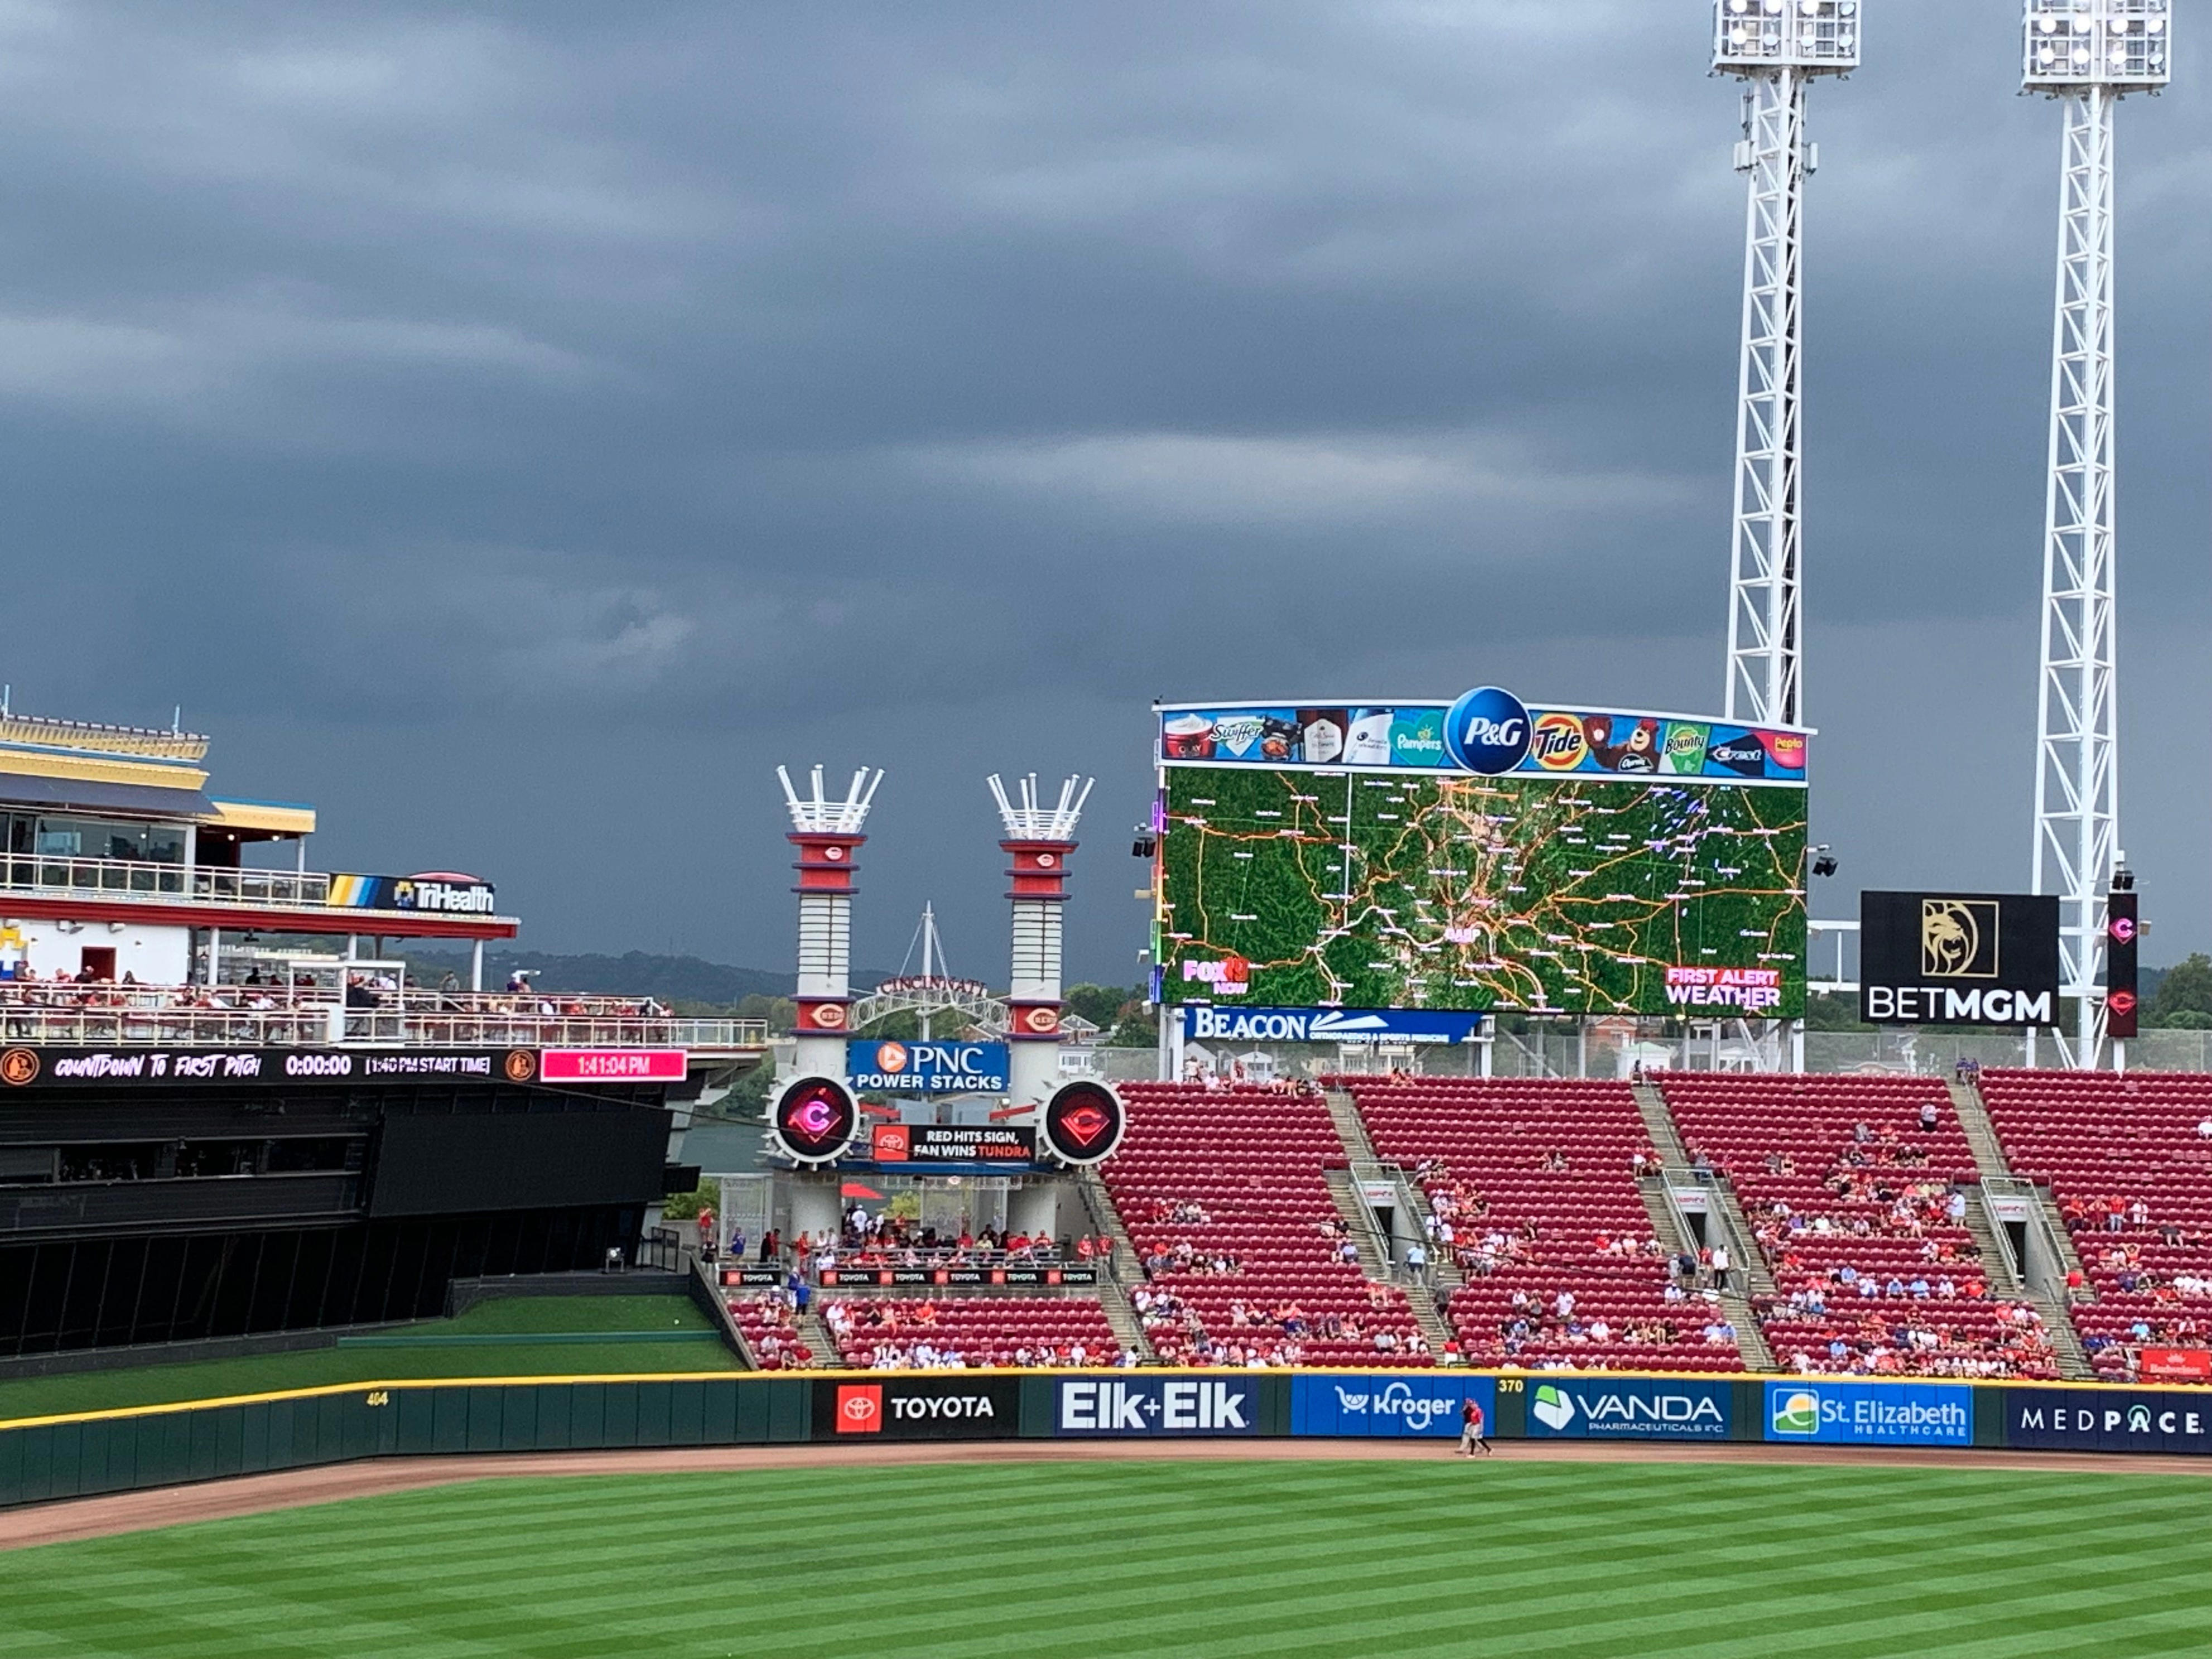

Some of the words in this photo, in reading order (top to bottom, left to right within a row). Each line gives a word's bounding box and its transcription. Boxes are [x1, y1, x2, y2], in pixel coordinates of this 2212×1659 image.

[1209, 724, 1263, 745] Swiffer
[1463, 716, 1524, 746] P&G
[1397, 732, 1442, 752] Pampers
[1536, 727, 1582, 759] Tide
[1665, 736, 1705, 755] Bounty
[1712, 746, 1762, 761] Crest
[414, 882, 494, 912] TriHealth
[880, 975, 987, 997] CINCINNATI
[1667, 968, 1718, 984] FIRST
[1720, 969, 1779, 986] ALERT
[1213, 982, 1249, 995] NOW
[1665, 984, 1781, 1006] WEATHER
[1868, 987, 2051, 1023] BETMGM
[1194, 1008, 1308, 1040] BEACON
[55, 1054, 145, 1078] COUNTDOWN
[150, 1054, 170, 1077] TO
[175, 1054, 227, 1078] FIRST
[224, 1054, 262, 1078] PITCH
[286, 1055, 352, 1075] 0:00:00
[419, 1057, 460, 1073] START
[629, 1057, 650, 1074] PM
[909, 1046, 984, 1074] PNC
[857, 1074, 924, 1088] POWER
[931, 1075, 1003, 1089] STACKS
[926, 1130, 953, 1142] RED
[954, 1131, 983, 1142] HITS
[984, 1131, 1019, 1144] SIGN,
[913, 1144, 940, 1156] FAN
[941, 1145, 976, 1156] WINS
[977, 1145, 1031, 1157] TUNDRA
[743, 1274, 774, 1282] TOYOTA
[1006, 1273, 1037, 1281] TOYOTA
[1498, 1379, 1524, 1393] 370
[366, 1391, 389, 1406] 404
[891, 1396, 994, 1420] TOYOTA
[1372, 1381, 1455, 1430] Kroger
[1577, 1395, 1723, 1423] VANDA
[1821, 1398, 1849, 1423] St.
[1855, 1400, 1966, 1425] Elizabeth
[1588, 1422, 1701, 1432] PHARMACEUTICALS
[2020, 1406, 2200, 1434] MEDPACE
[1855, 1426, 1966, 1437] HEALTHCARE
